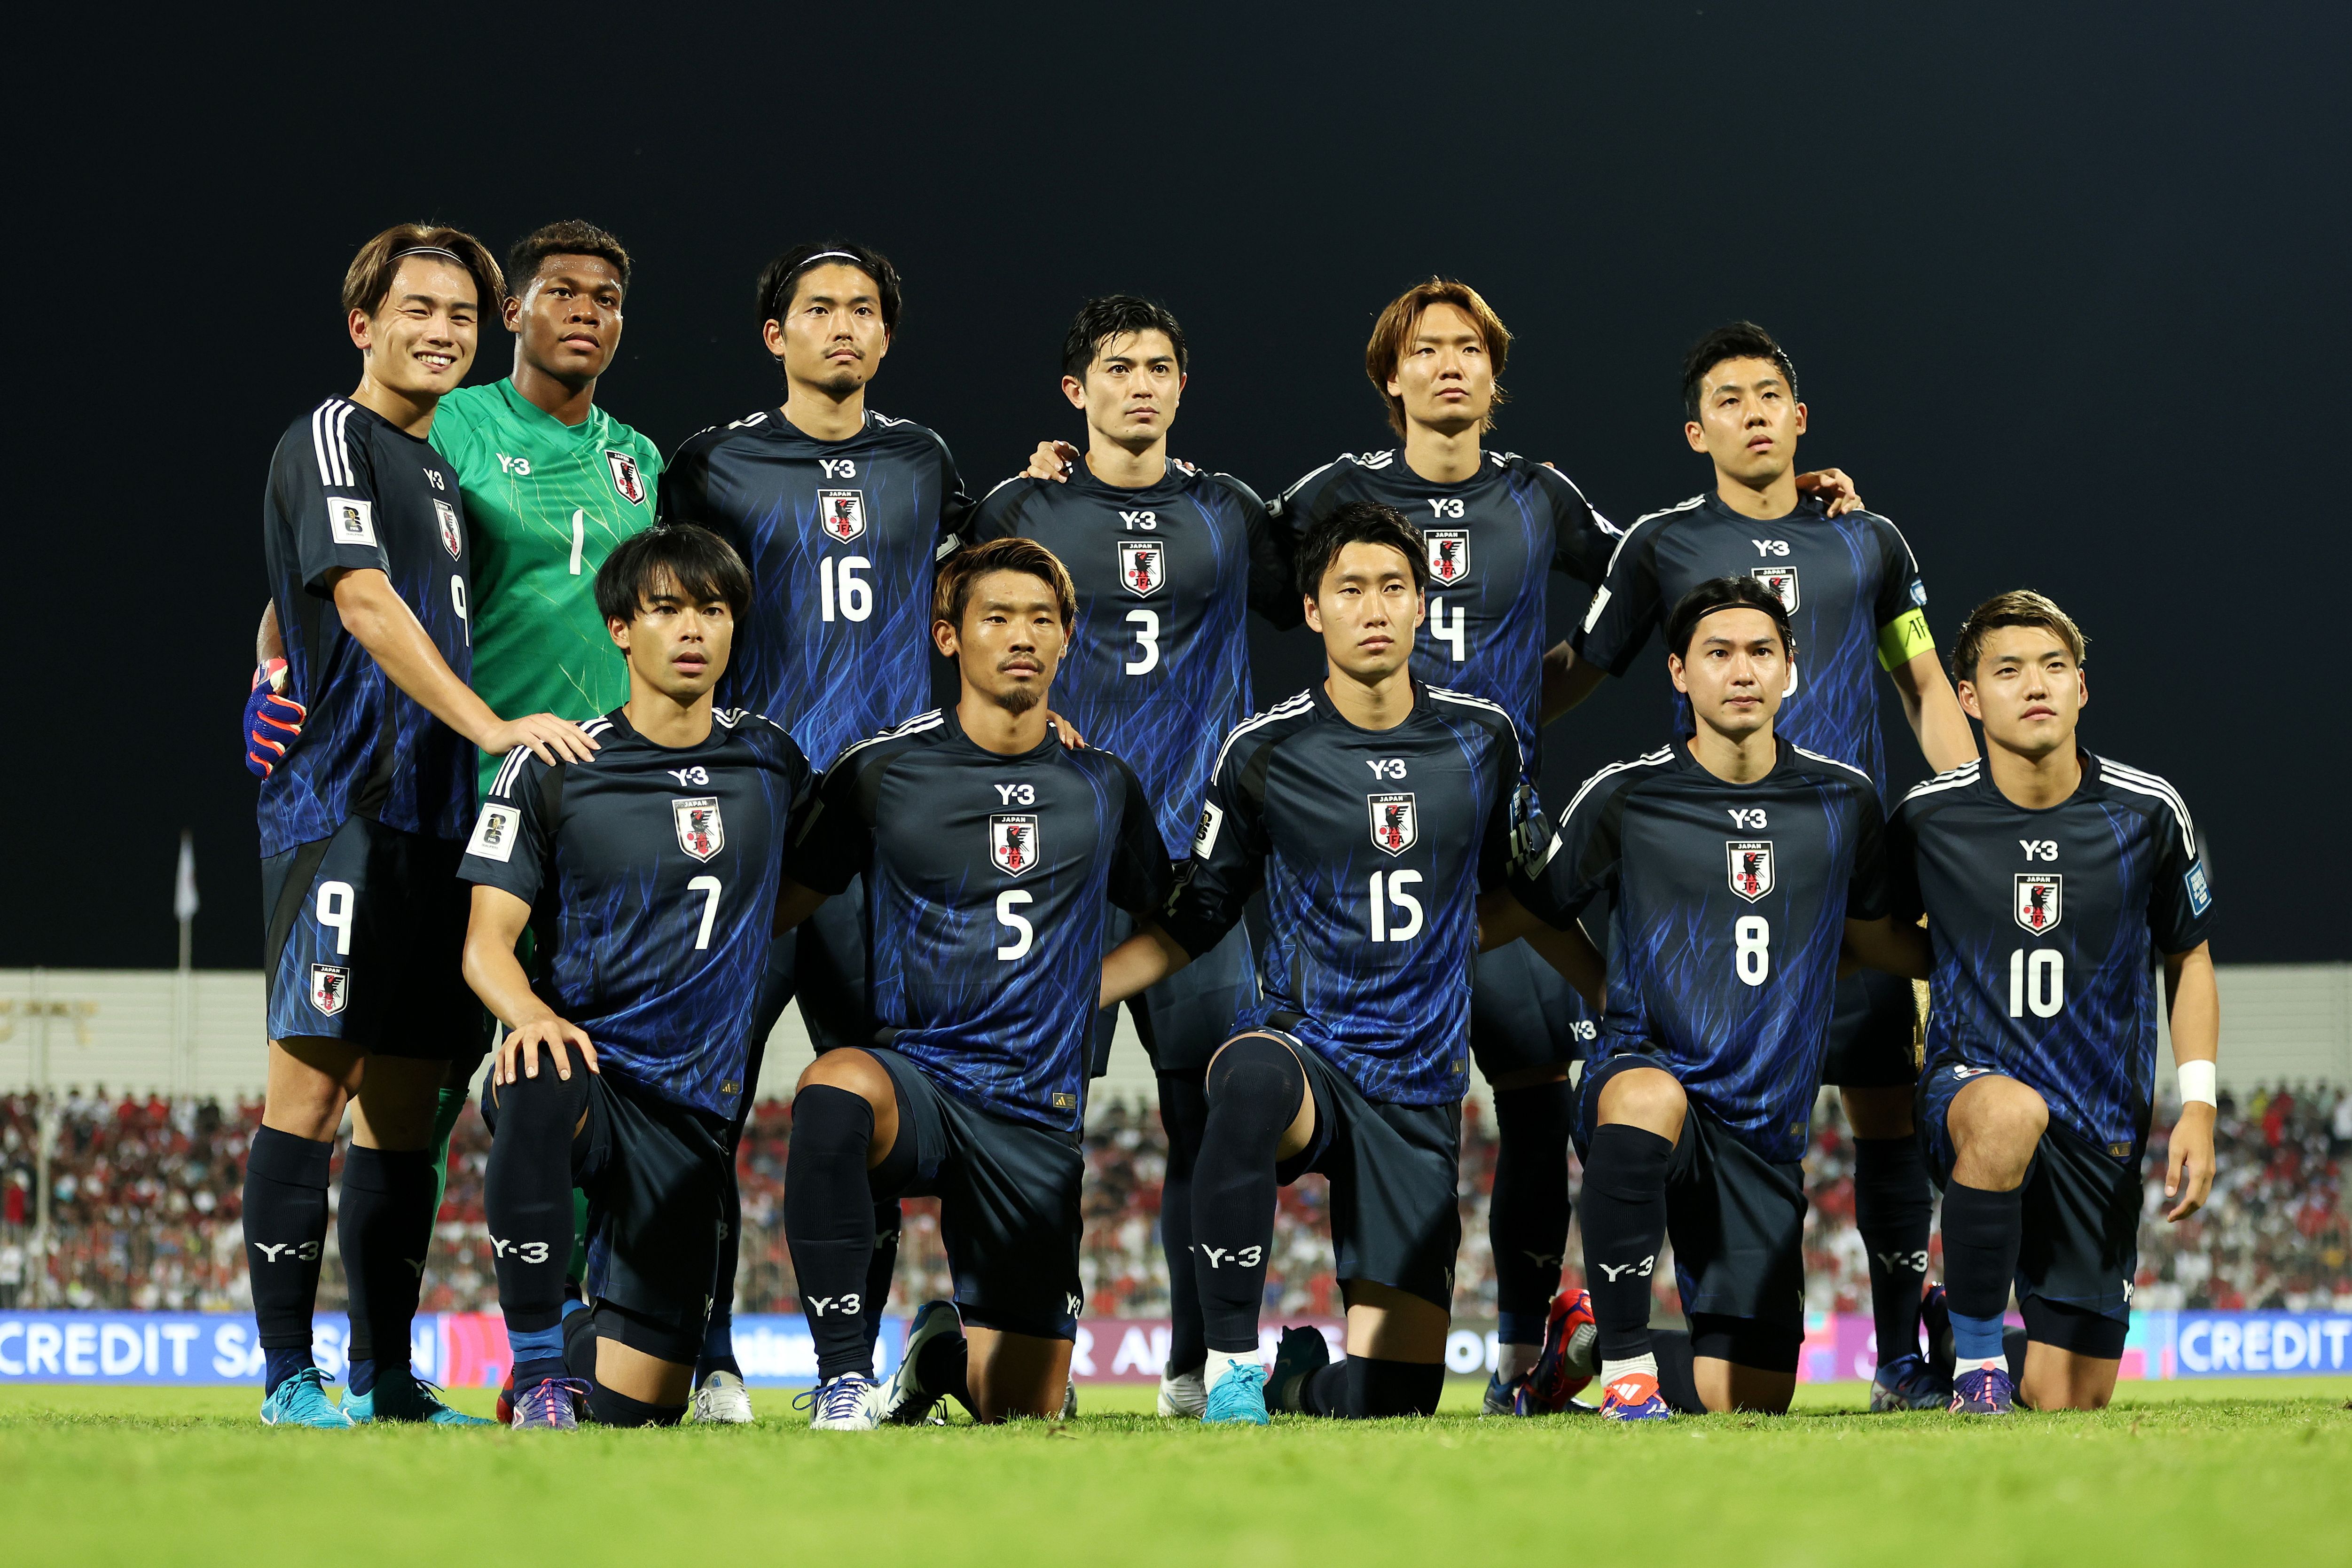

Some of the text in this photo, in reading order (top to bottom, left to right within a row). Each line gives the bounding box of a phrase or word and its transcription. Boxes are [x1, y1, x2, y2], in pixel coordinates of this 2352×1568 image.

[495, 452, 531, 476] Y-3
[614, 453, 629, 462] JAPAN
[818, 459, 856, 479] Y-3
[423, 468, 445, 491] Y-3
[625, 487, 638, 497] JFA
[1427, 498, 1465, 518] Y-3
[835, 525, 854, 533] JFA
[1118, 511, 1157, 530] Y-3
[570, 509, 584, 575] 1
[1751, 539, 1790, 557] Y-3
[1133, 578, 1152, 587] JFA
[1438, 567, 1457, 575] JFA
[820, 556, 873, 622] 16
[451, 574, 470, 648] 9
[1430, 596, 1465, 661] 4
[1905, 616, 1926, 648] AF
[1125, 609, 1160, 675] 3
[667, 766, 709, 787] Y-3
[1365, 758, 1407, 780] Y-3
[994, 784, 1035, 805] Y-3
[1727, 808, 1767, 829] Y-3
[693, 839, 713, 851] JFA
[1385, 835, 1405, 845] JFA
[2019, 839, 2059, 862] Y-3
[1004, 855, 1026, 865] JFA
[1742, 882, 1762, 891] JFA
[687, 876, 722, 950] 7
[1369, 869, 1424, 942] 15
[316, 880, 354, 956] 9
[996, 889, 1034, 961] 5
[2028, 915, 2047, 924] JFA
[1735, 915, 1770, 987] 8
[2010, 948, 2064, 1018] 10
[1568, 1019, 1597, 1042] Y-3
[254, 1241, 319, 1262] Y-3
[489, 1234, 549, 1264] Y-3
[1201, 1244, 1262, 1269] Y-3
[1598, 1255, 1655, 1283] Y-3
[1878, 1250, 1929, 1274] Y-3
[807, 1293, 861, 1317] Y-3
[1066, 1291, 1081, 1320] Y-3
[0, 1322, 199, 1376] CREDIT
[2179, 1319, 2352, 1372] CREDIT
